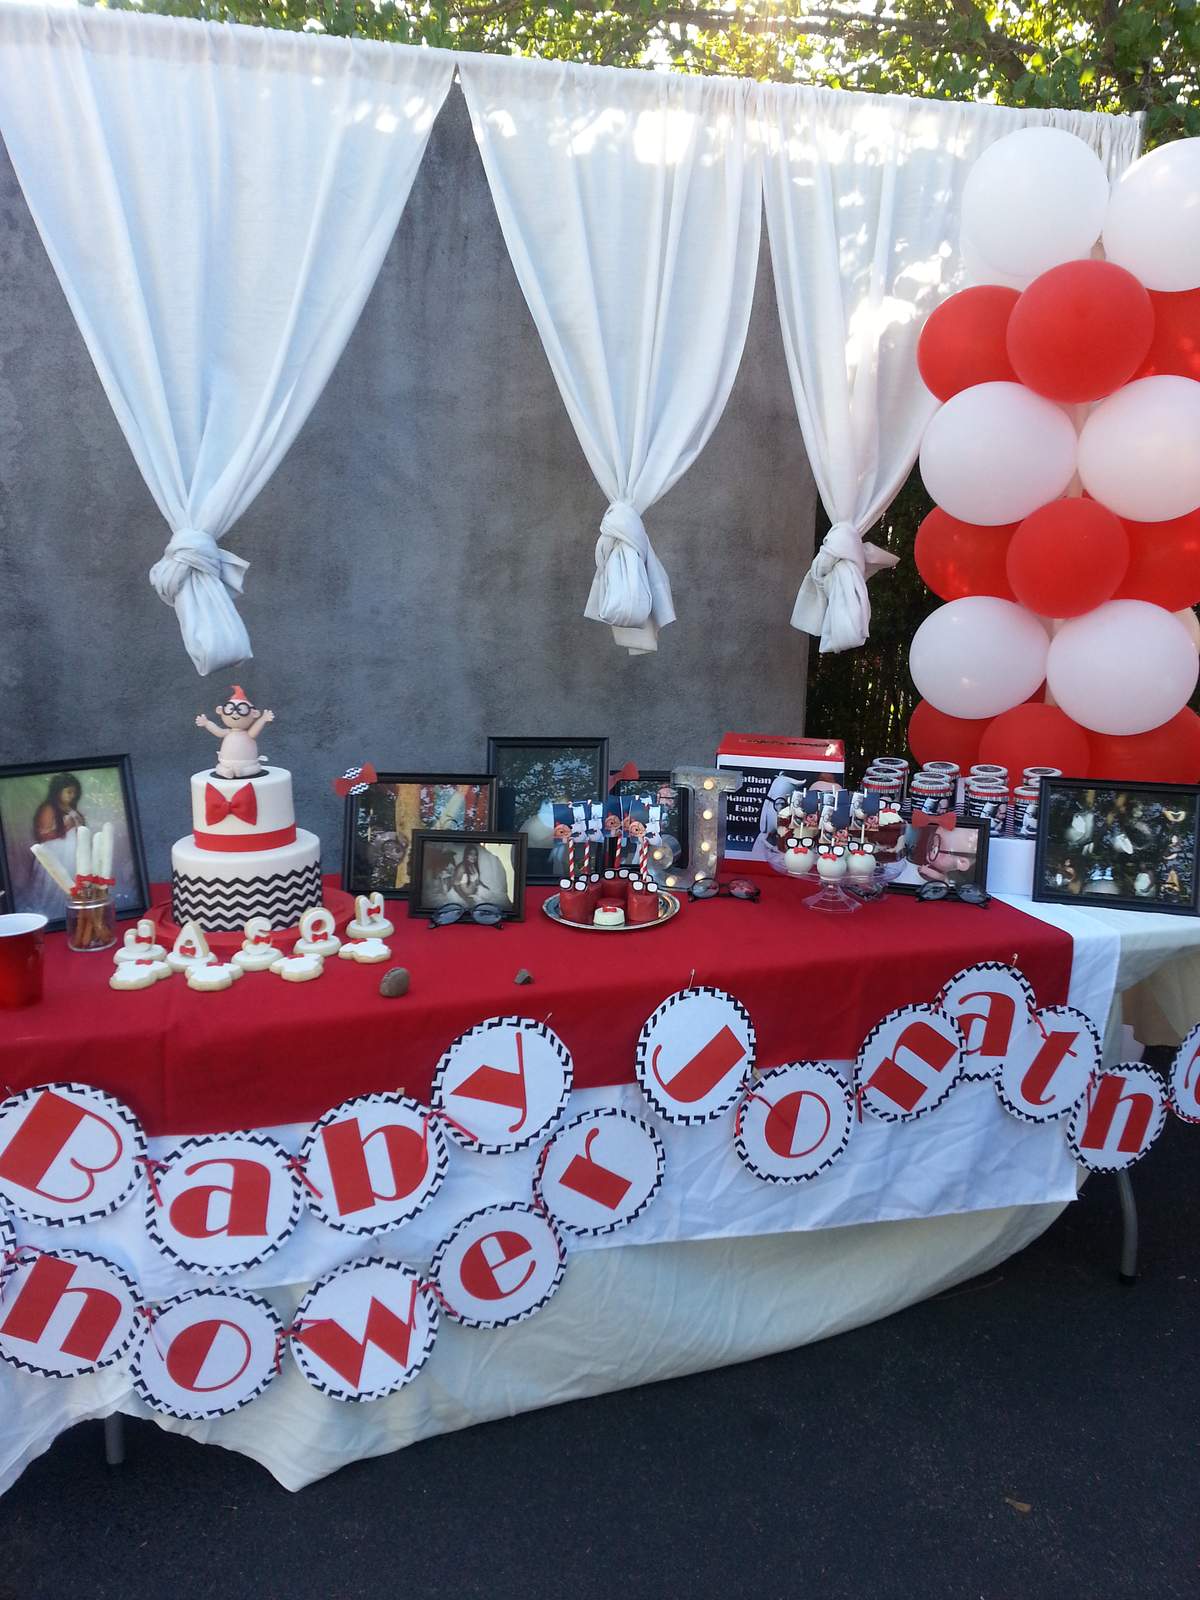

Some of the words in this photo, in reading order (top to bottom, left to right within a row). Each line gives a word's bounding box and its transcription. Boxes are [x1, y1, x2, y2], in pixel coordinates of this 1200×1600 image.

[746, 786, 767, 794] and
[735, 804, 760, 813] Baby
[0, 1127, 632, 1392] hower
